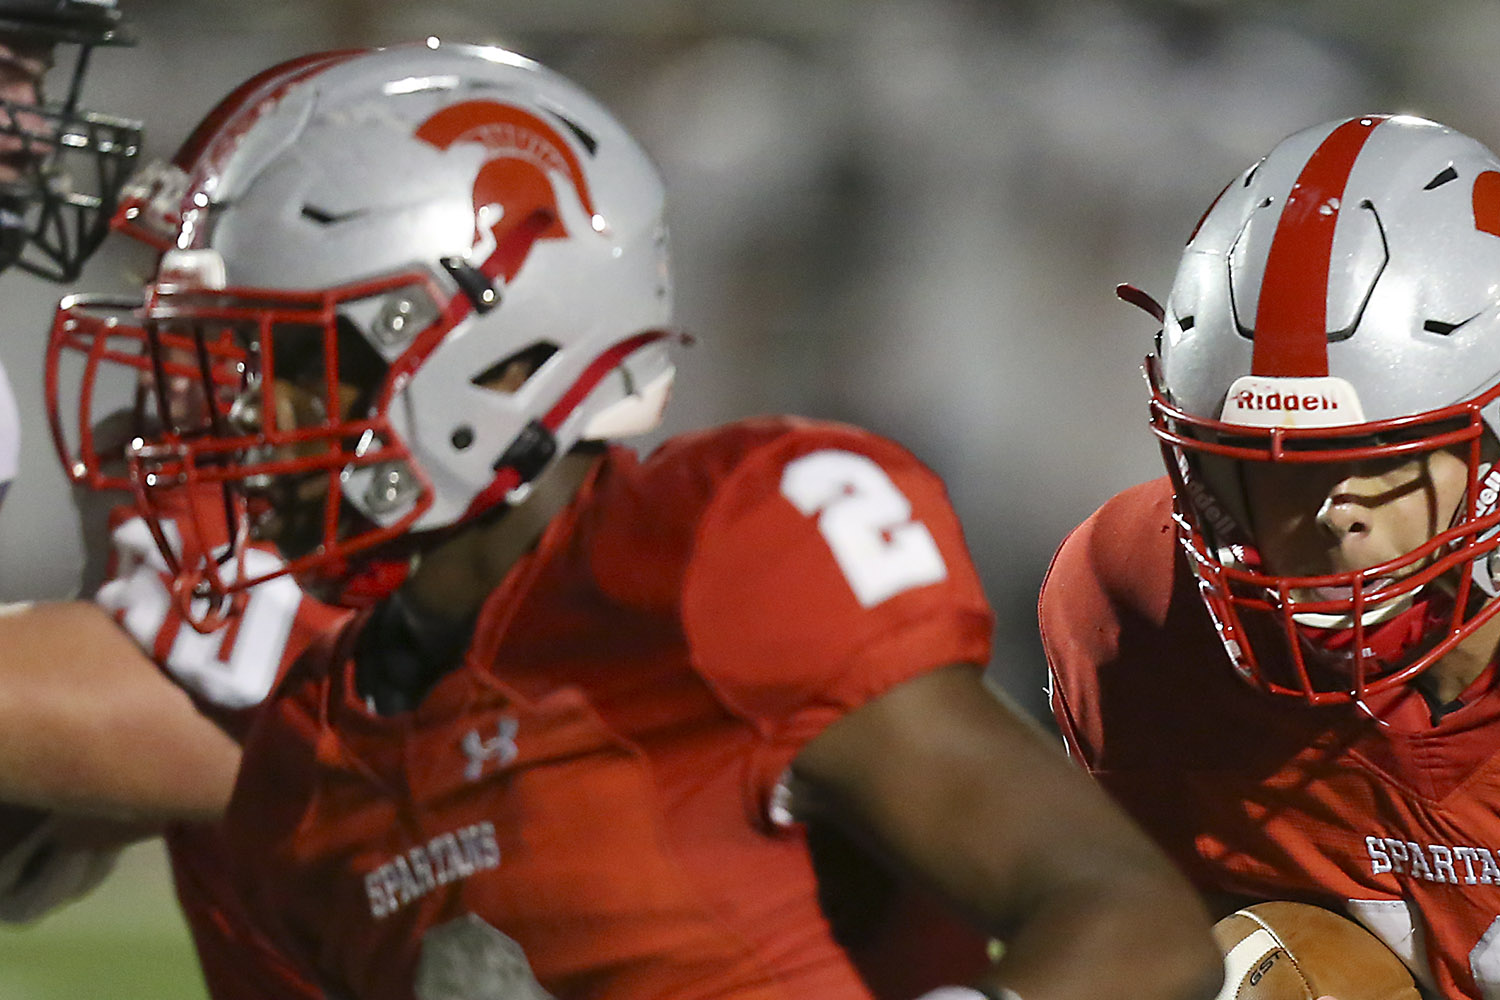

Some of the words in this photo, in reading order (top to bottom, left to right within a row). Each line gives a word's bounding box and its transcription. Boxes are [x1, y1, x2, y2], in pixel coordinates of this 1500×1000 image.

[1237, 389, 1338, 411] Riddell
[779, 448, 948, 609] 2
[364, 820, 500, 918] SPARTANS
[1250, 950, 1282, 986] GST
